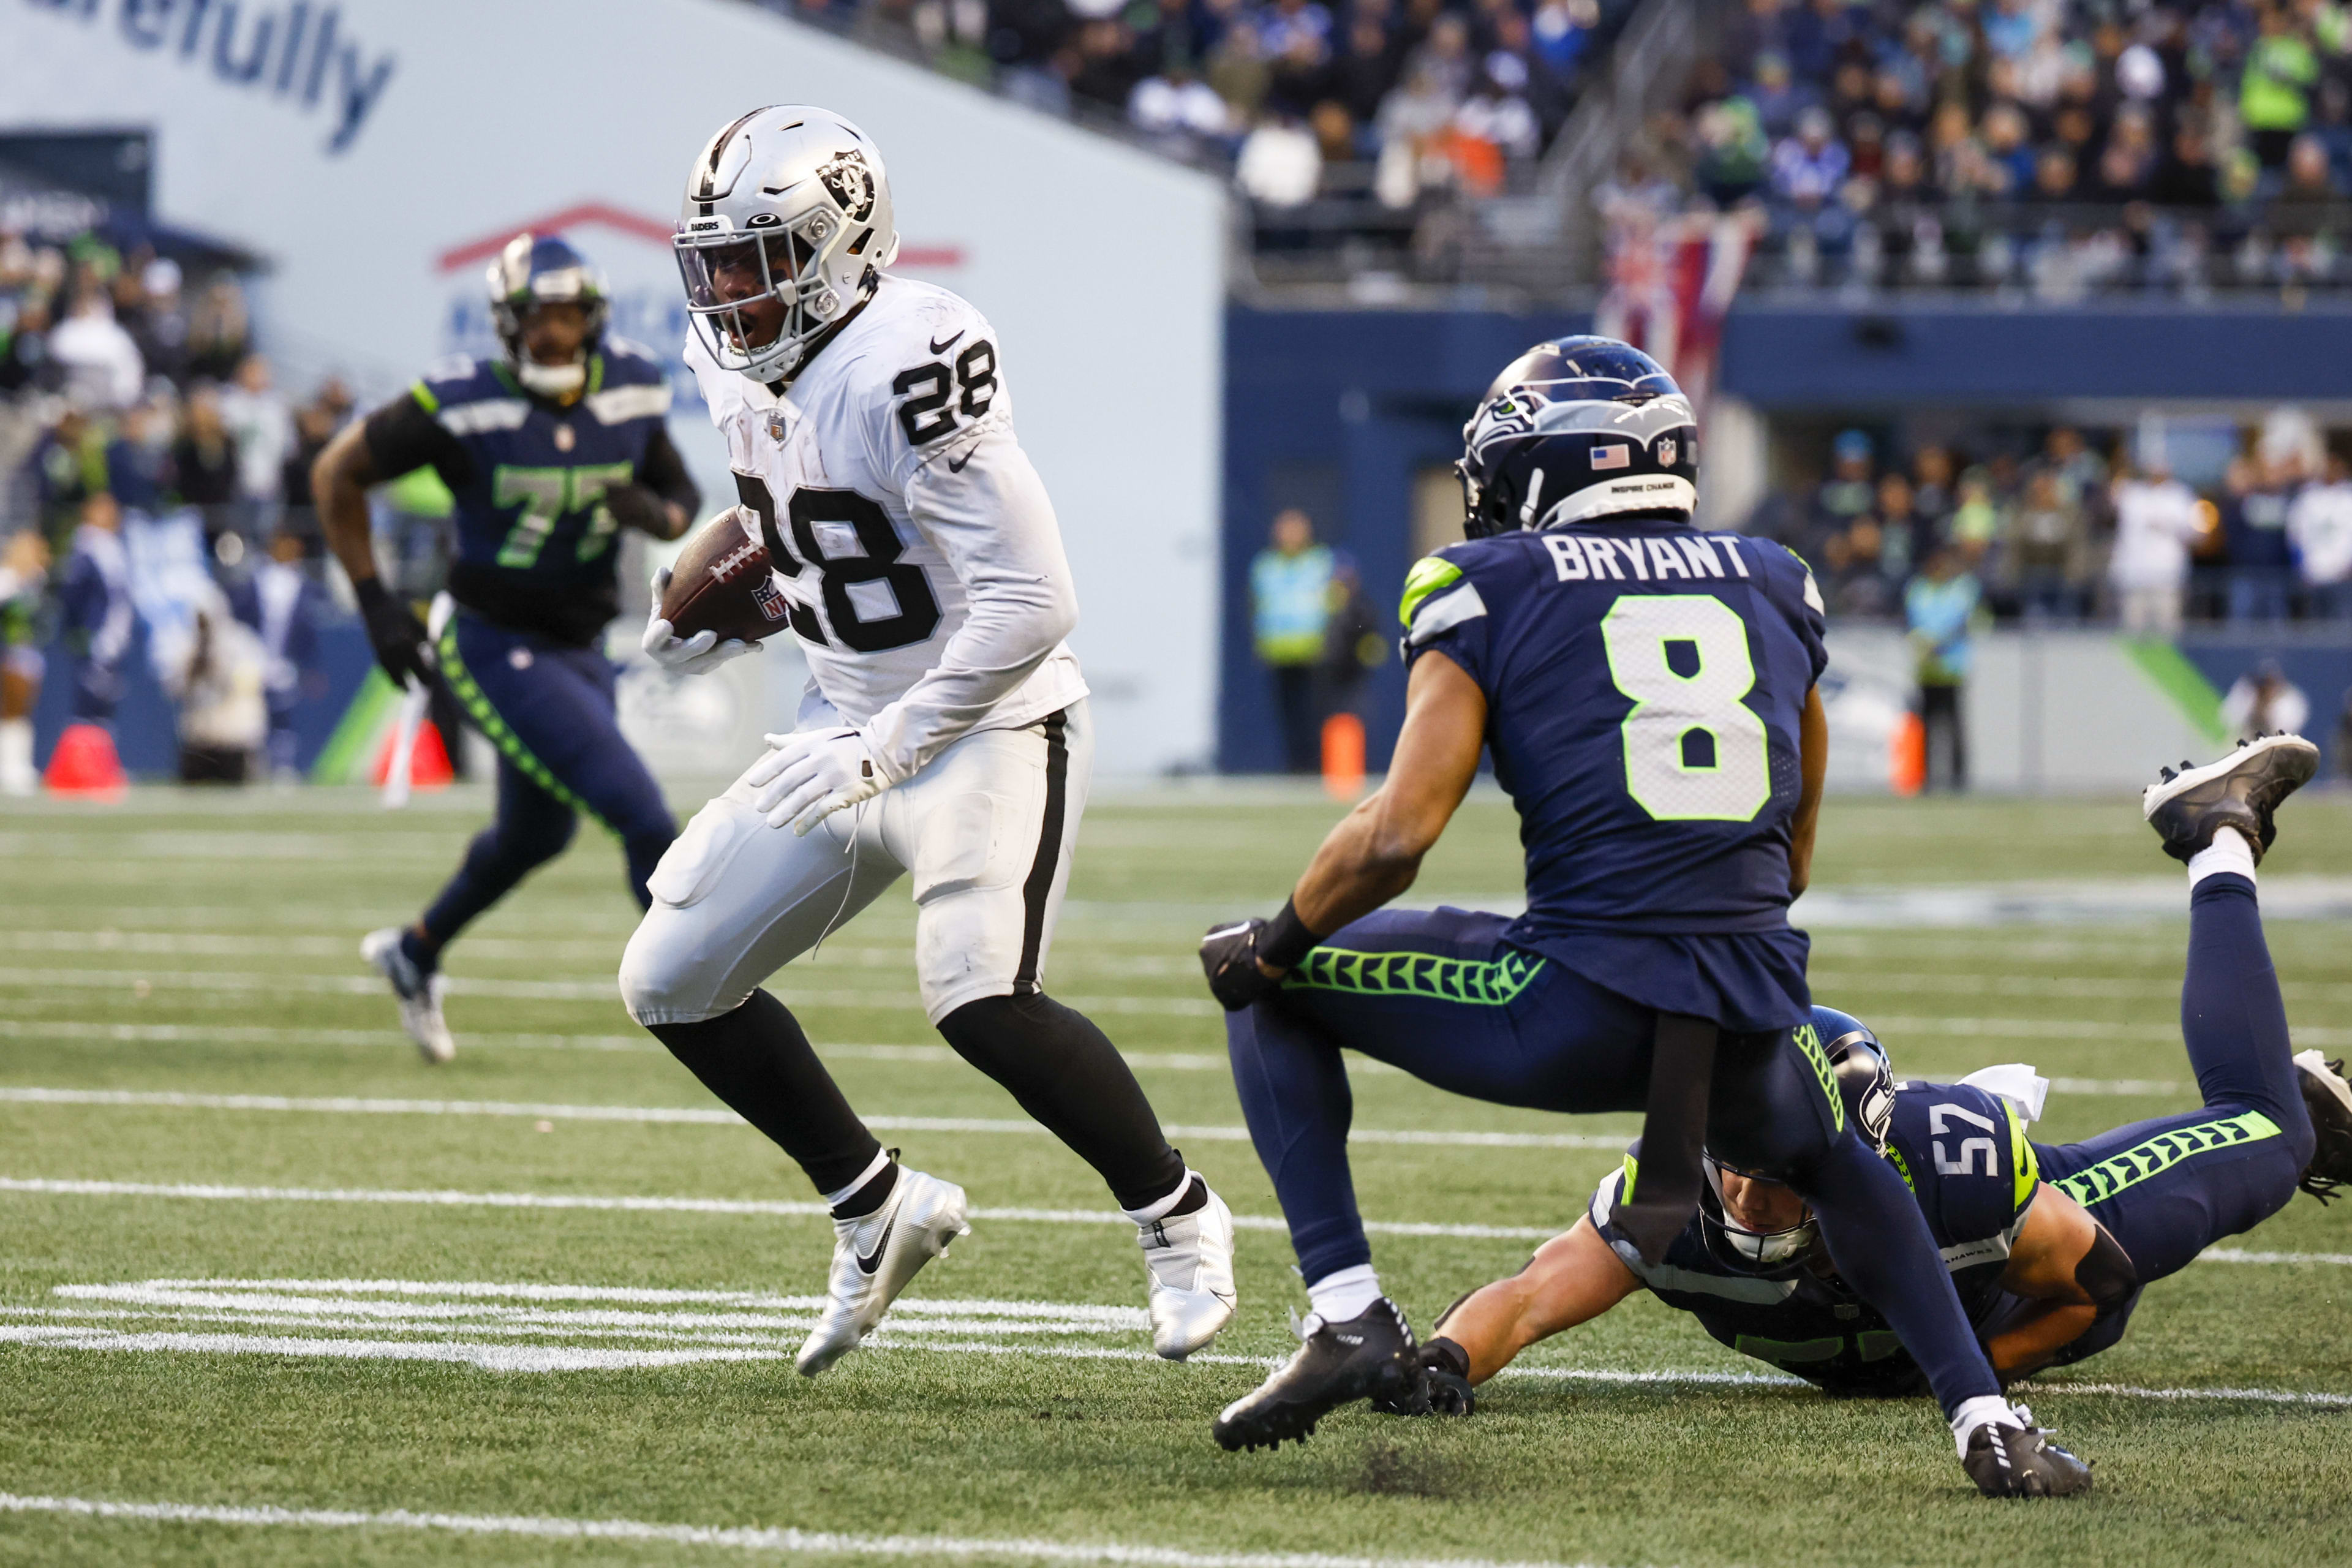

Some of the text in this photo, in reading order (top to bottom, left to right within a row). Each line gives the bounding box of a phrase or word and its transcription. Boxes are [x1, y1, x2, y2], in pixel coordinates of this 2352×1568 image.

[26, 0, 393, 153] efully
[691, 221, 719, 232] RAIDERS
[892, 339, 998, 446] 28
[492, 460, 635, 568] 77
[1541, 534, 1750, 581] BRYANT
[1599, 594, 1771, 822] 8
[1928, 1102, 1999, 1177] 57
